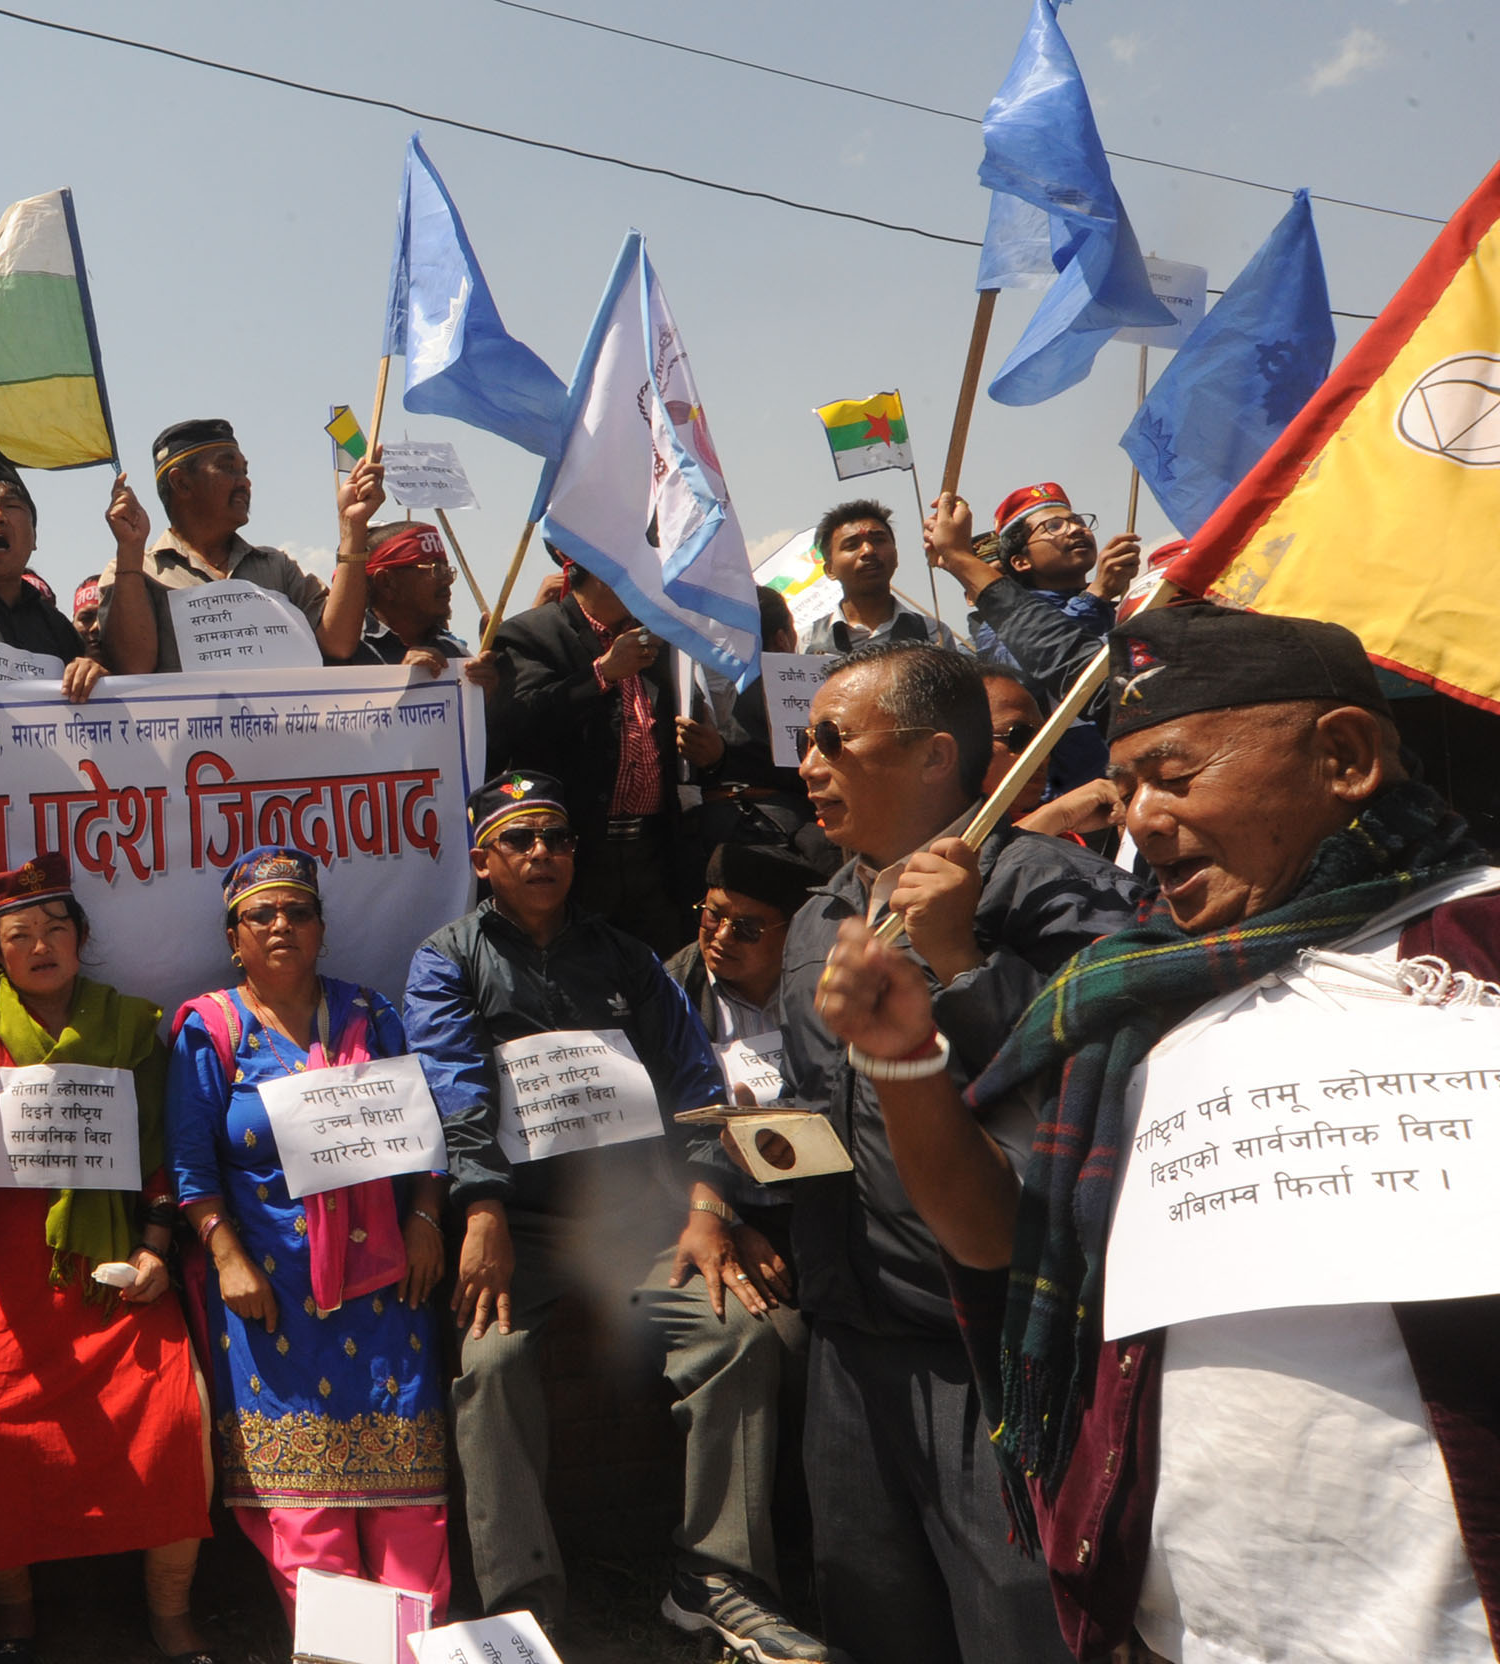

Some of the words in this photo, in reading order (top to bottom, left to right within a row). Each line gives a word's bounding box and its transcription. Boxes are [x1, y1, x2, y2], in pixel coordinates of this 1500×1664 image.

[190, 610, 233, 626] सरकारी
[194, 624, 258, 643] कामकाजको
[198, 648, 231, 662] कायम
[11, 722, 57, 749] मगरात
[65, 712, 111, 749] पहिचान
[119, 720, 129, 745] र
[136, 718, 179, 745] स्वायत्त
[187, 716, 222, 740] शासन
[230, 706, 278, 743] सहितको
[286, 704, 320, 735] संघीय
[516, 1073, 550, 1094] दिइने
[300, 1080, 396, 1108] मातृभाषामा
[21, 1103, 53, 1120] दिइने
[512, 1093, 580, 1119] सार्वजनिक
[310, 1114, 353, 1134] उच्च
[360, 1106, 405, 1127] शिक्षा
[592, 1111, 612, 1124] गर
[1134, 1110, 1186, 1153] राष्ट्रिय
[1197, 1086, 1233, 1121] पर्व
[1248, 1083, 1310, 1113] तमू
[11, 1126, 78, 1144] सार्वजनिक
[384, 1137, 408, 1153] गर
[1151, 1142, 1219, 1187] दिइएको
[1232, 1121, 1380, 1159] सार्वजनिक
[1398, 1114, 1473, 1143] विदा
[84, 1155, 103, 1168] गर
[1273, 1165, 1353, 1200] फिर्ता
[1371, 1170, 1419, 1192] गर
